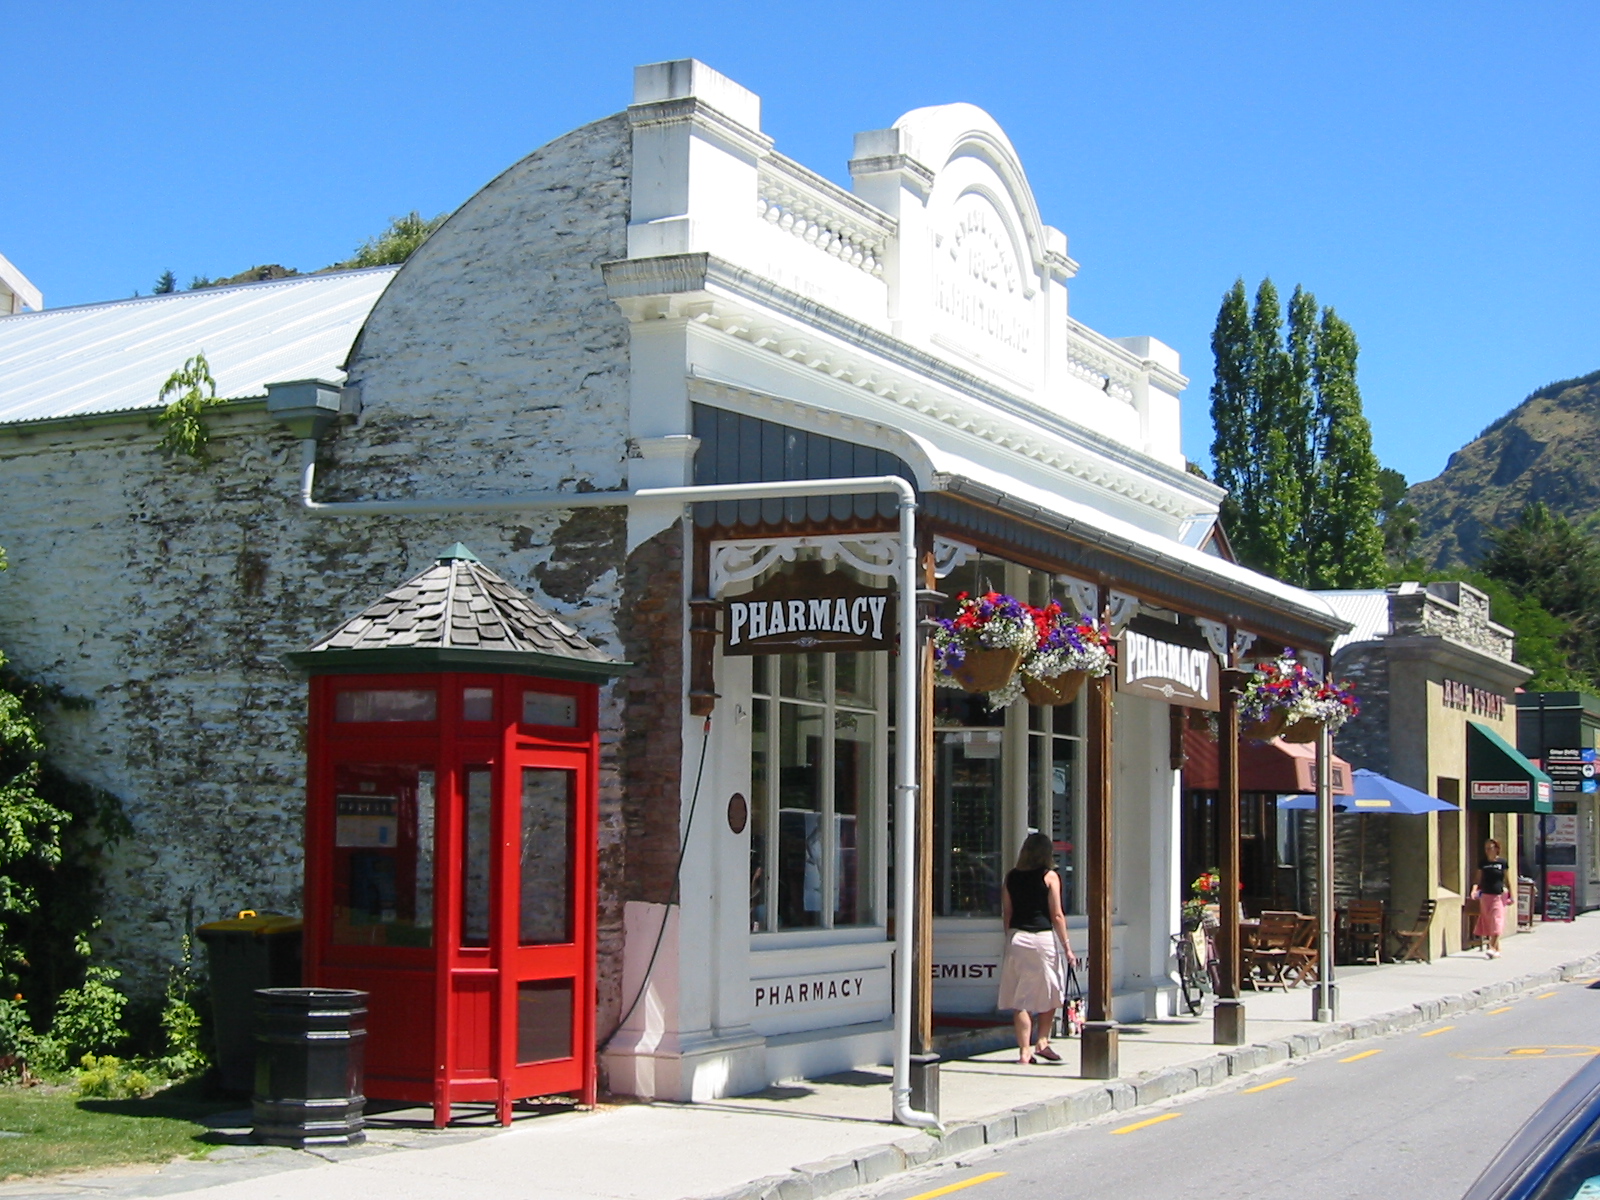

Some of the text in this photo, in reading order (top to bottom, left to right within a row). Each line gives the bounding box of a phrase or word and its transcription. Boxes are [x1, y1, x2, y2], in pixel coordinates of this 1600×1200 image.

[729, 596, 887, 646] PHARMACY
[1125, 629, 1210, 701] PHARMACY
[1444, 678, 1507, 717] REAL ESTATE
[1474, 783, 1527, 794] Locations
[755, 977, 863, 1007] PHARMACY
